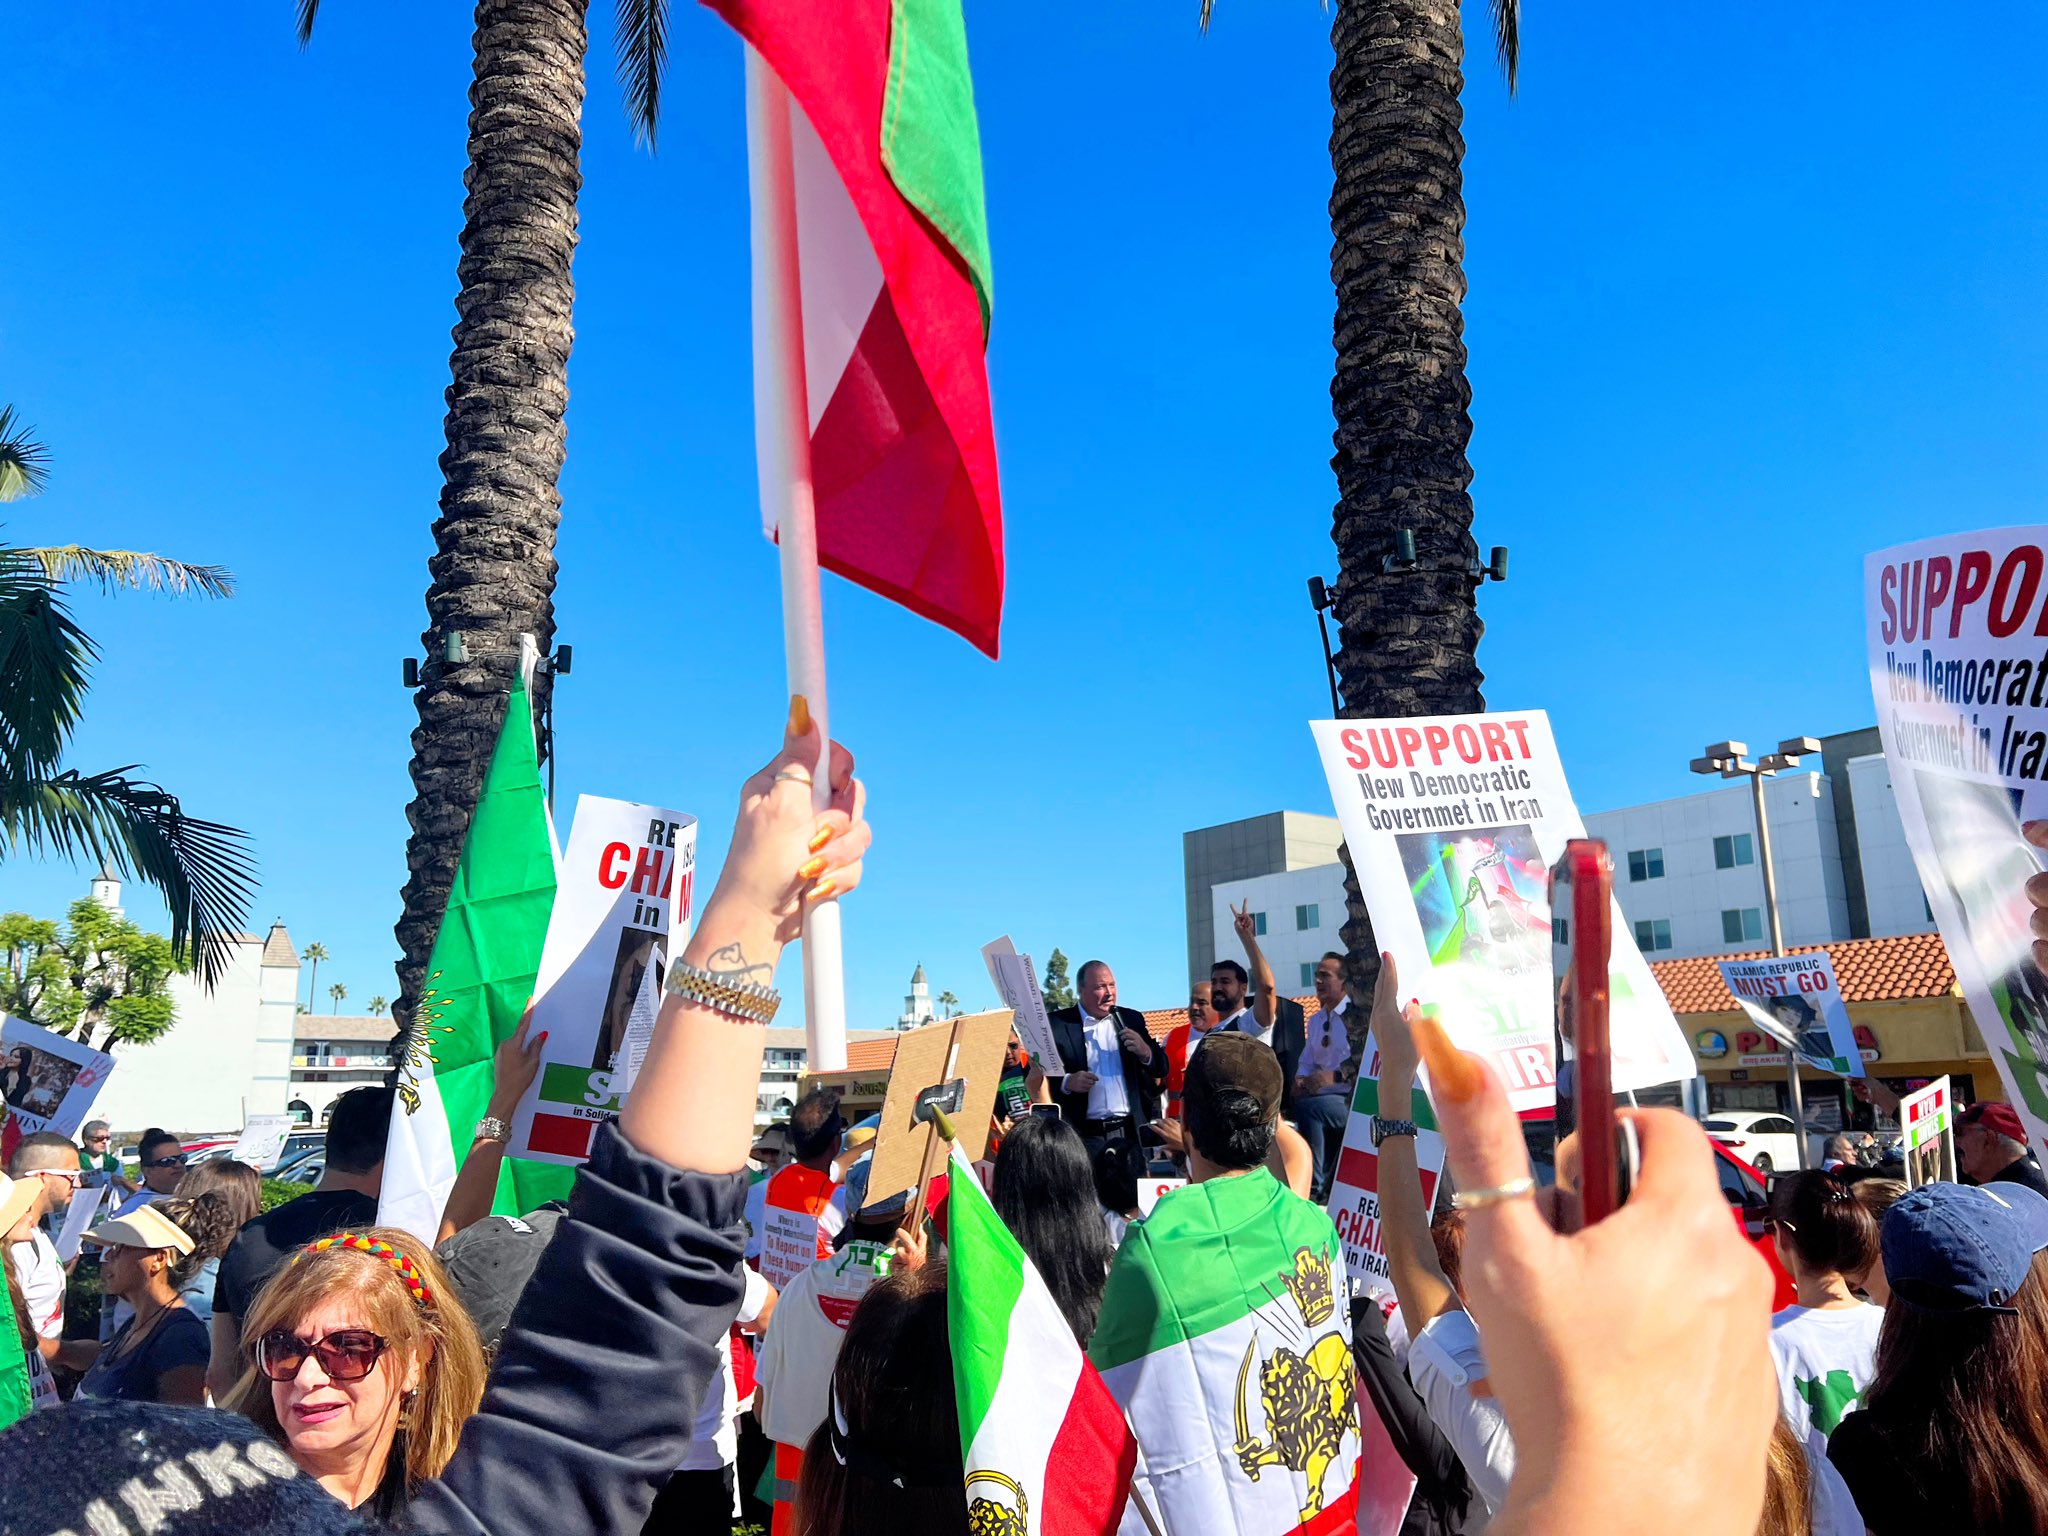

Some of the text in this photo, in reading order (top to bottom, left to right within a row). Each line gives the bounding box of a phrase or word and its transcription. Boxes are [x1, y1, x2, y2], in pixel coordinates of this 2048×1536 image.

[1887, 648, 2048, 709] New Democrat
[1340, 719, 1532, 770] SUPPORT
[1972, 713, 1991, 774] in
[1357, 764, 1531, 800] New Democratic
[1366, 795, 1543, 831] Governmet in Iran
[633, 898, 660, 928] in
[1729, 959, 1820, 977] ISLAMIC REPUBLIC
[1733, 970, 1829, 998] MUST GO
[1735, 1024, 1878, 1054] PIA
[573, 1106, 611, 1120] in Solid
[1358, 1196, 1380, 1220] REG
[1346, 1246, 1359, 1267] in
